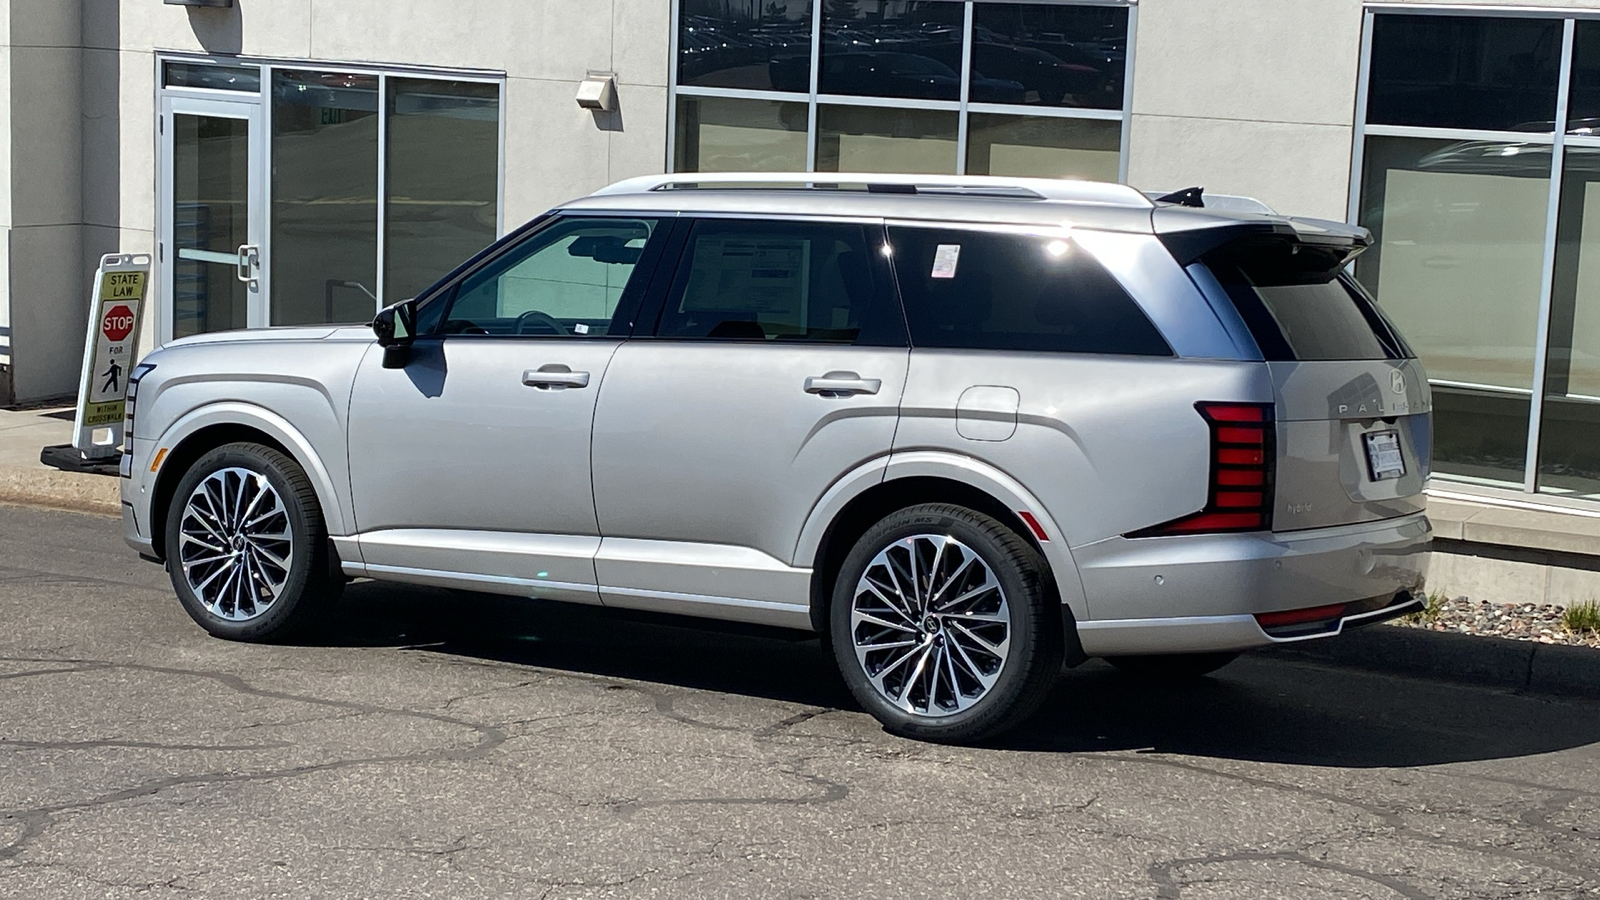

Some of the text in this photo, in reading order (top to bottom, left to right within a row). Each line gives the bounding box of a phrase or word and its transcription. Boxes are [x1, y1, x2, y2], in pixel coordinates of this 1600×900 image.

[111, 275, 138, 285] STATE
[113, 287, 133, 296] LAW
[104, 316, 133, 330] STOP
[109, 346, 123, 354] FOR
[97, 405, 117, 413] WITHIN
[88, 413, 122, 423] CROSSWALK
